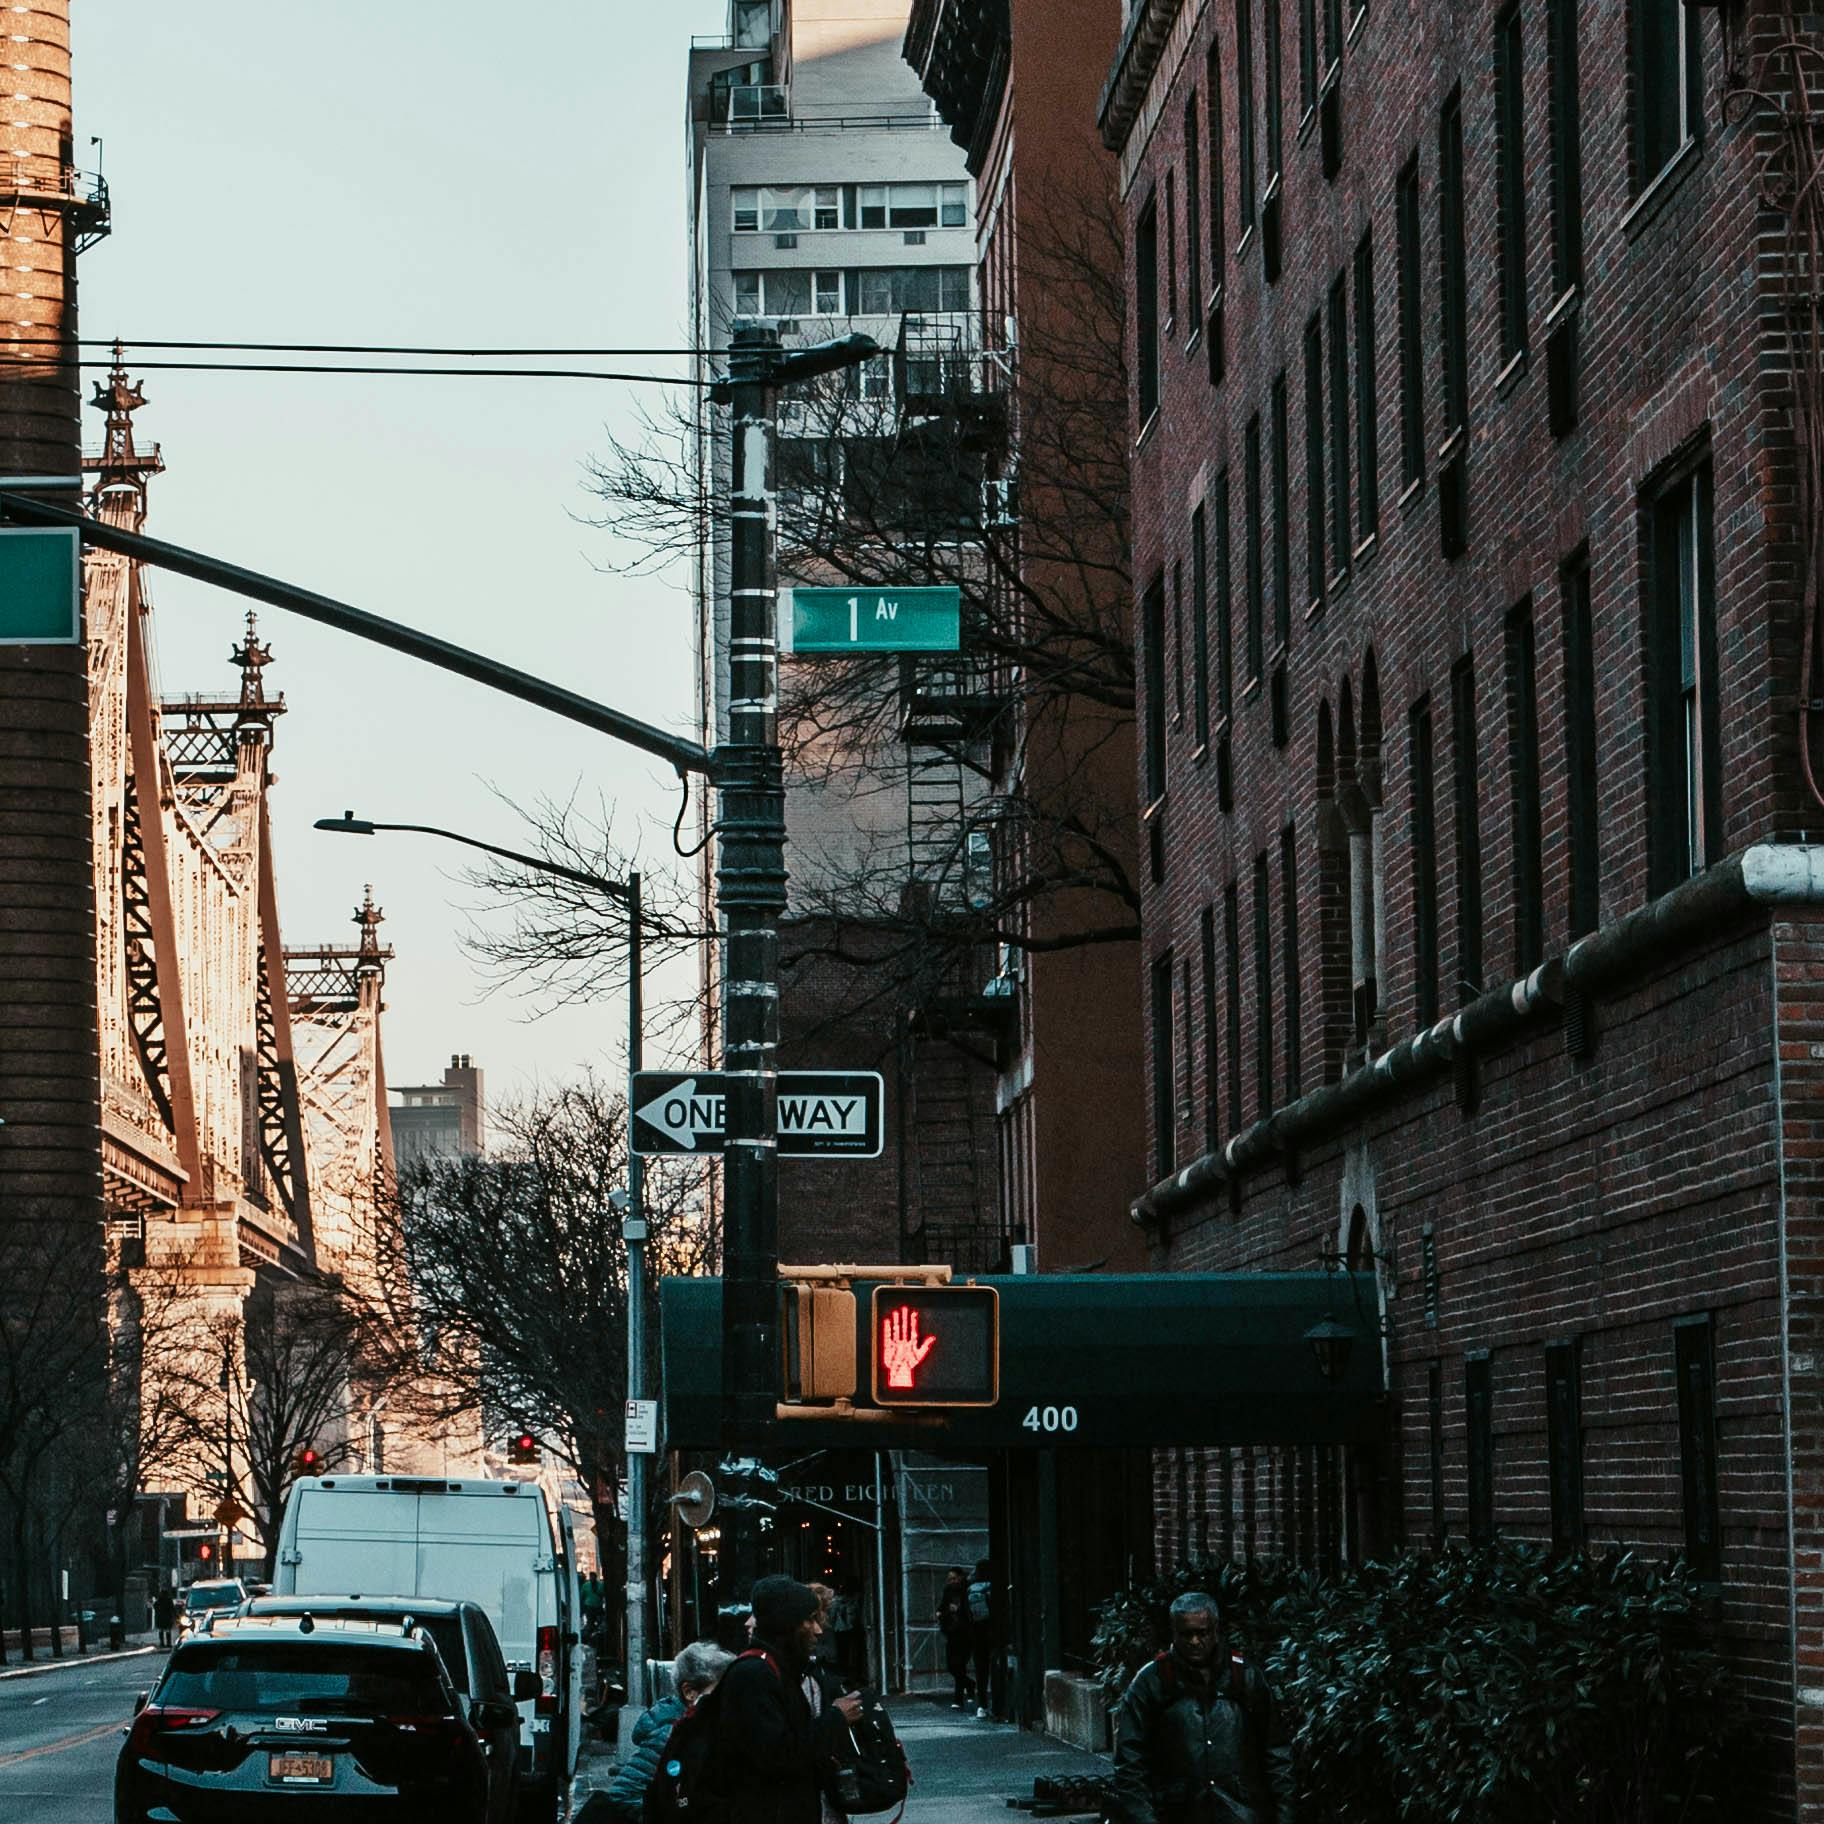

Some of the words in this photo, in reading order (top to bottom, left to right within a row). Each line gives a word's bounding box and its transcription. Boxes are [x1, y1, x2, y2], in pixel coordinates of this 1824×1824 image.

[847, 597, 859, 642] 1
[875, 597, 899, 621] Av
[664, 1098, 726, 1129] ONE
[778, 1099, 858, 1130] WAY
[1022, 1405, 1079, 1433] 400
[275, 1717, 328, 1732] GMC
